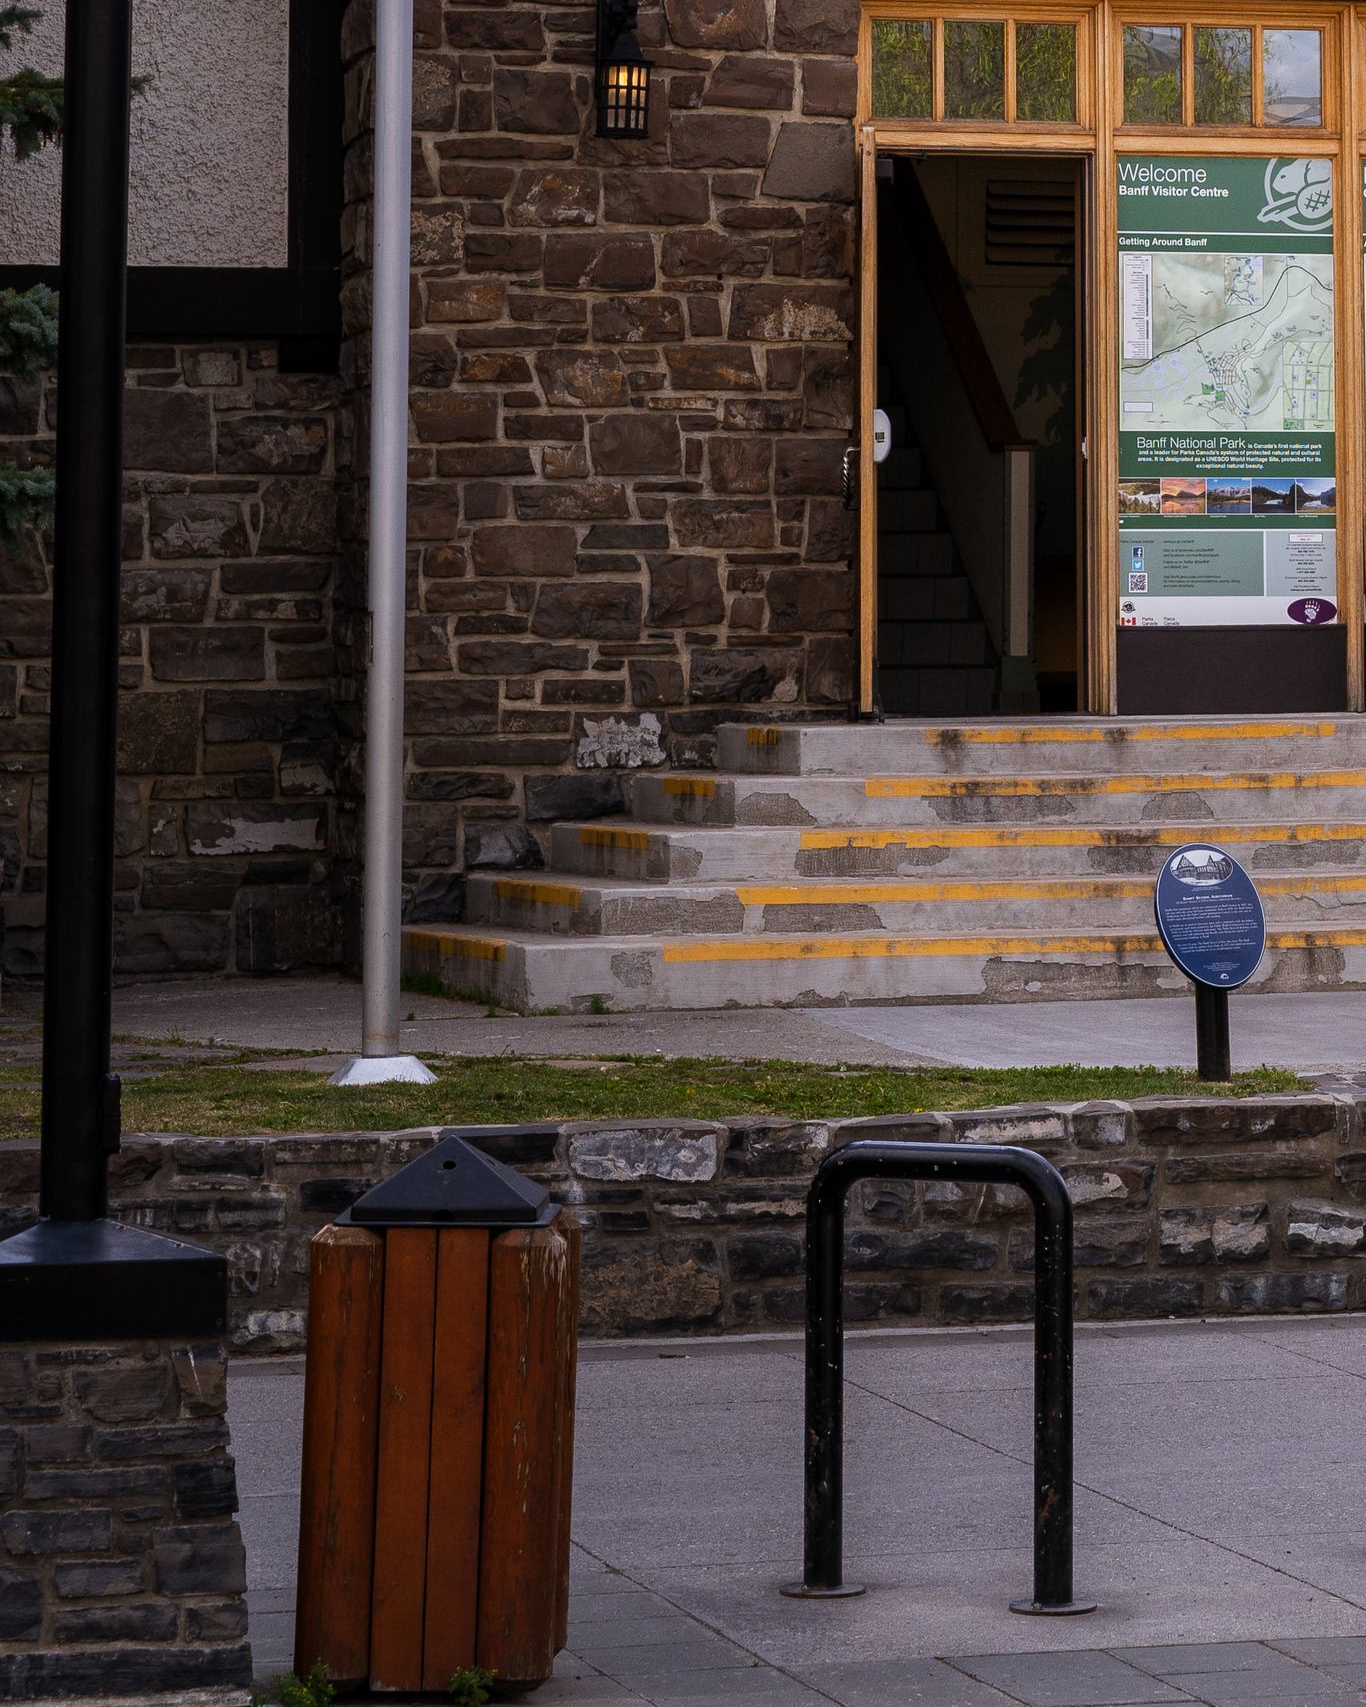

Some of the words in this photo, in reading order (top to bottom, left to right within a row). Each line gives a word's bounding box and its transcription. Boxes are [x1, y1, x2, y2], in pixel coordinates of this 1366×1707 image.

[1119, 163, 1207, 183] Welcome
[1119, 185, 1149, 197] Banff
[1151, 185, 1188, 197] Visitor
[1190, 186, 1229, 198] Centre
[1119, 237, 1150, 247] Getting
[1152, 237, 1183, 246] Around
[1184, 238, 1208, 247] Banff
[1136, 436, 1167, 449] Banff
[1170, 436, 1217, 449] National
[1219, 437, 1246, 449] Park
